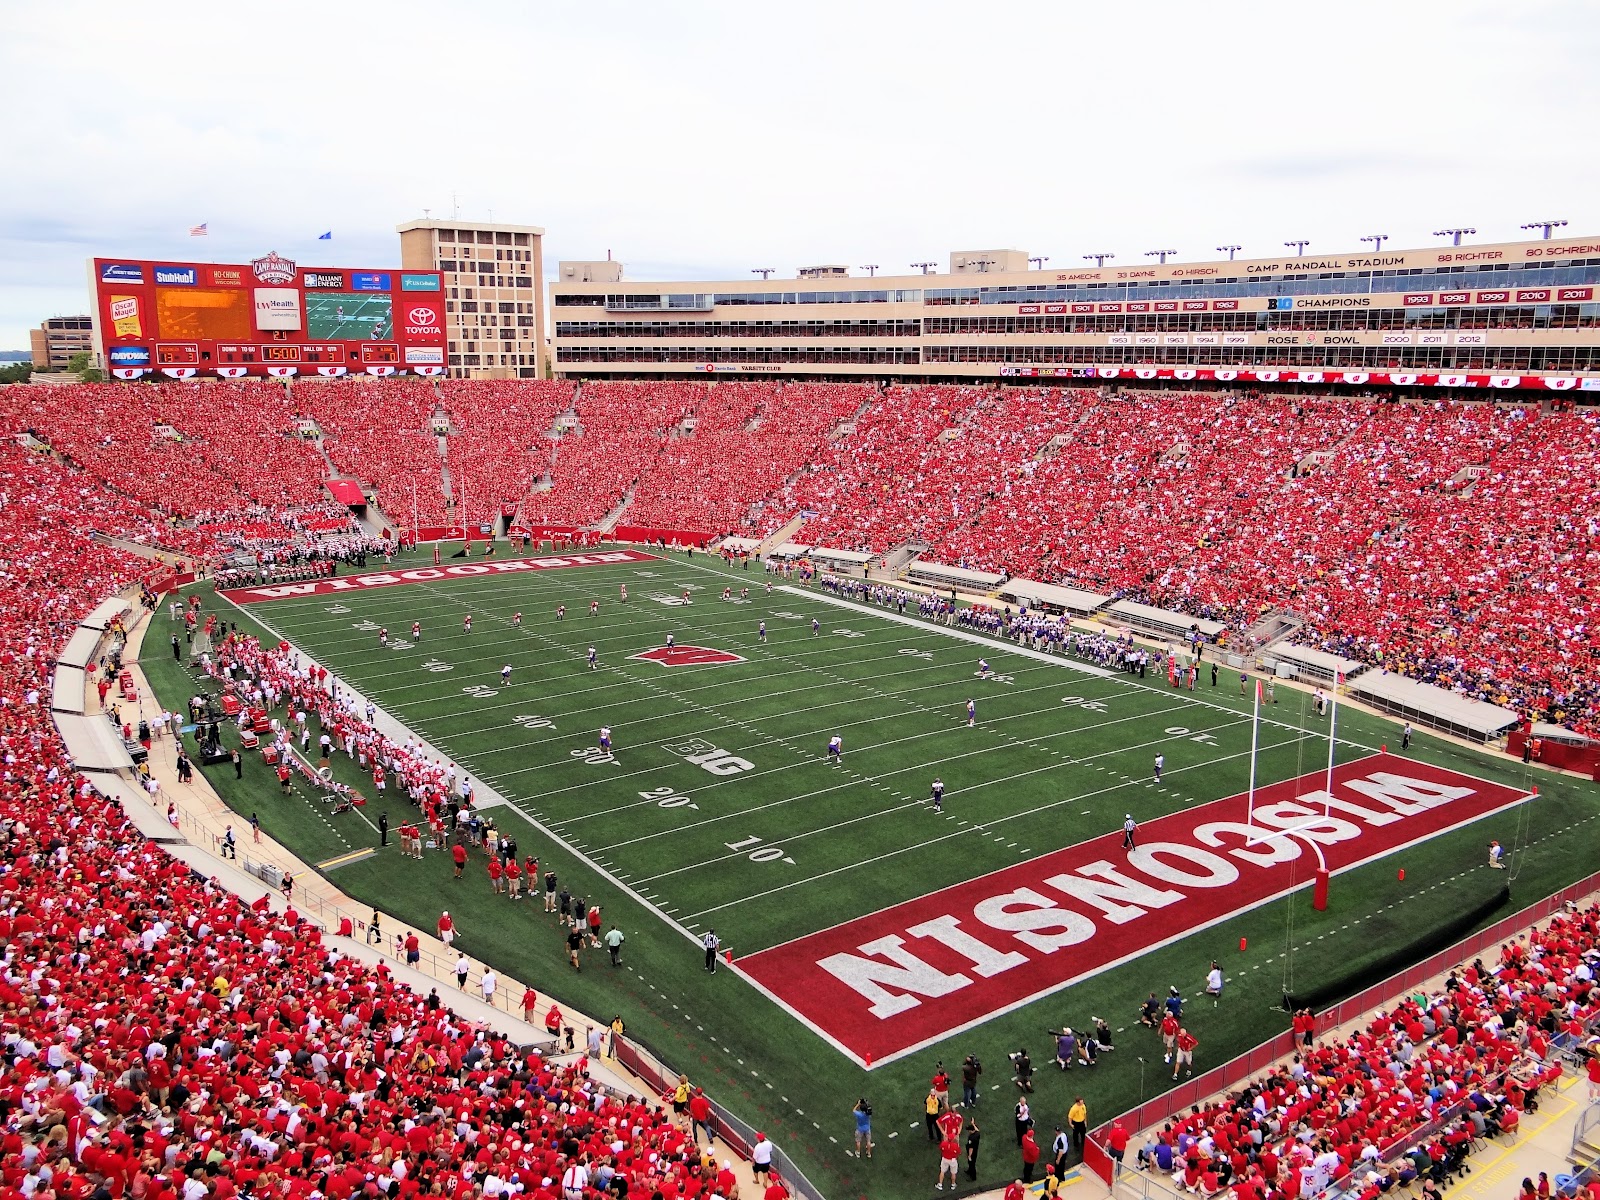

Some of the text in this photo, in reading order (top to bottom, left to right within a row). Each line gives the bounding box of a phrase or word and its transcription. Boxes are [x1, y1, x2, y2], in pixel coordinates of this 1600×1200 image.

[1438, 251, 1503, 262] 88 RICHTER
[1526, 248, 1542, 257] 80
[254, 262, 294, 276] CAMP RANDALL
[1246, 257, 1405, 273] CAMP RANDALL STADIUM
[156, 270, 194, 284] StubHub!
[213, 270, 241, 279] HO-CHUNK
[1406, 295, 1428, 303] 1993
[1442, 294, 1466, 302] 1998
[1480, 292, 1504, 300] 1999
[1520, 291, 1546, 300] 2010
[1562, 290, 1586, 298] 2011
[114, 301, 134, 311] Oscar
[1296, 298, 1370, 308] CHAMPIONS
[114, 306, 136, 318] Mayer
[404, 326, 442, 334] TOYOTA
[1268, 336, 1360, 344] ROSE BOWL
[110, 352, 150, 360] RAYOVAC
[188, 352, 194, 362] 3
[268, 347, 298, 360] 15:00
[328, 352, 334, 362] 3
[366, 352, 371, 360] 3
[390, 352, 396, 362] 0
[245, 552, 637, 598] WISCONSIN
[462, 684, 499, 698] 50
[512, 715, 552, 728] 40
[1164, 726, 1218, 742] 10
[570, 746, 615, 765] 30
[638, 786, 690, 808] 20
[724, 834, 784, 862] 10
[816, 770, 1476, 1020] WISCONSIN
